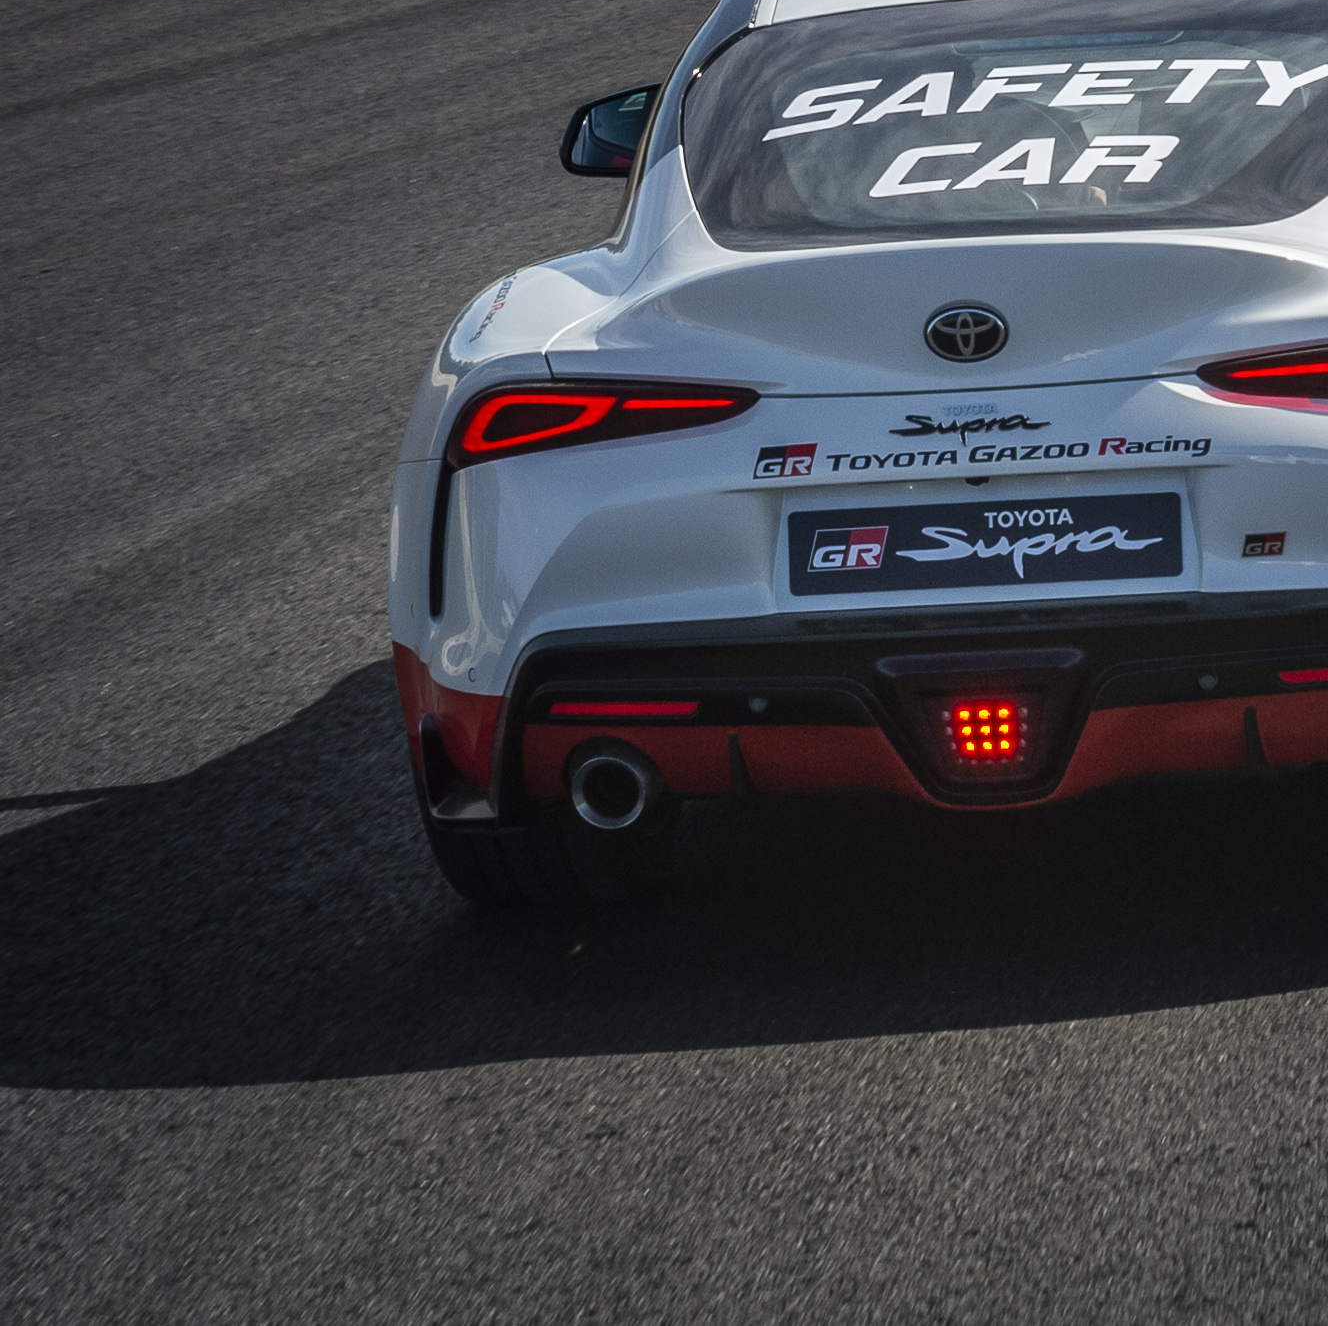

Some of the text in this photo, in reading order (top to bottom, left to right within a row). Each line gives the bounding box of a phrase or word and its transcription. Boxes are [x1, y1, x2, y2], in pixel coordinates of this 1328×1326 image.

[869, 135, 1180, 197] CAR
[943, 402, 998, 416] TOYOTA
[889, 414, 1052, 447] Supra
[826, 450, 958, 472] TOYOTA
[968, 442, 1090, 464] GAZOO
[1098, 434, 1212, 458] Racing
[984, 508, 1074, 529] TOYOTA
[896, 525, 1163, 579] Supra
